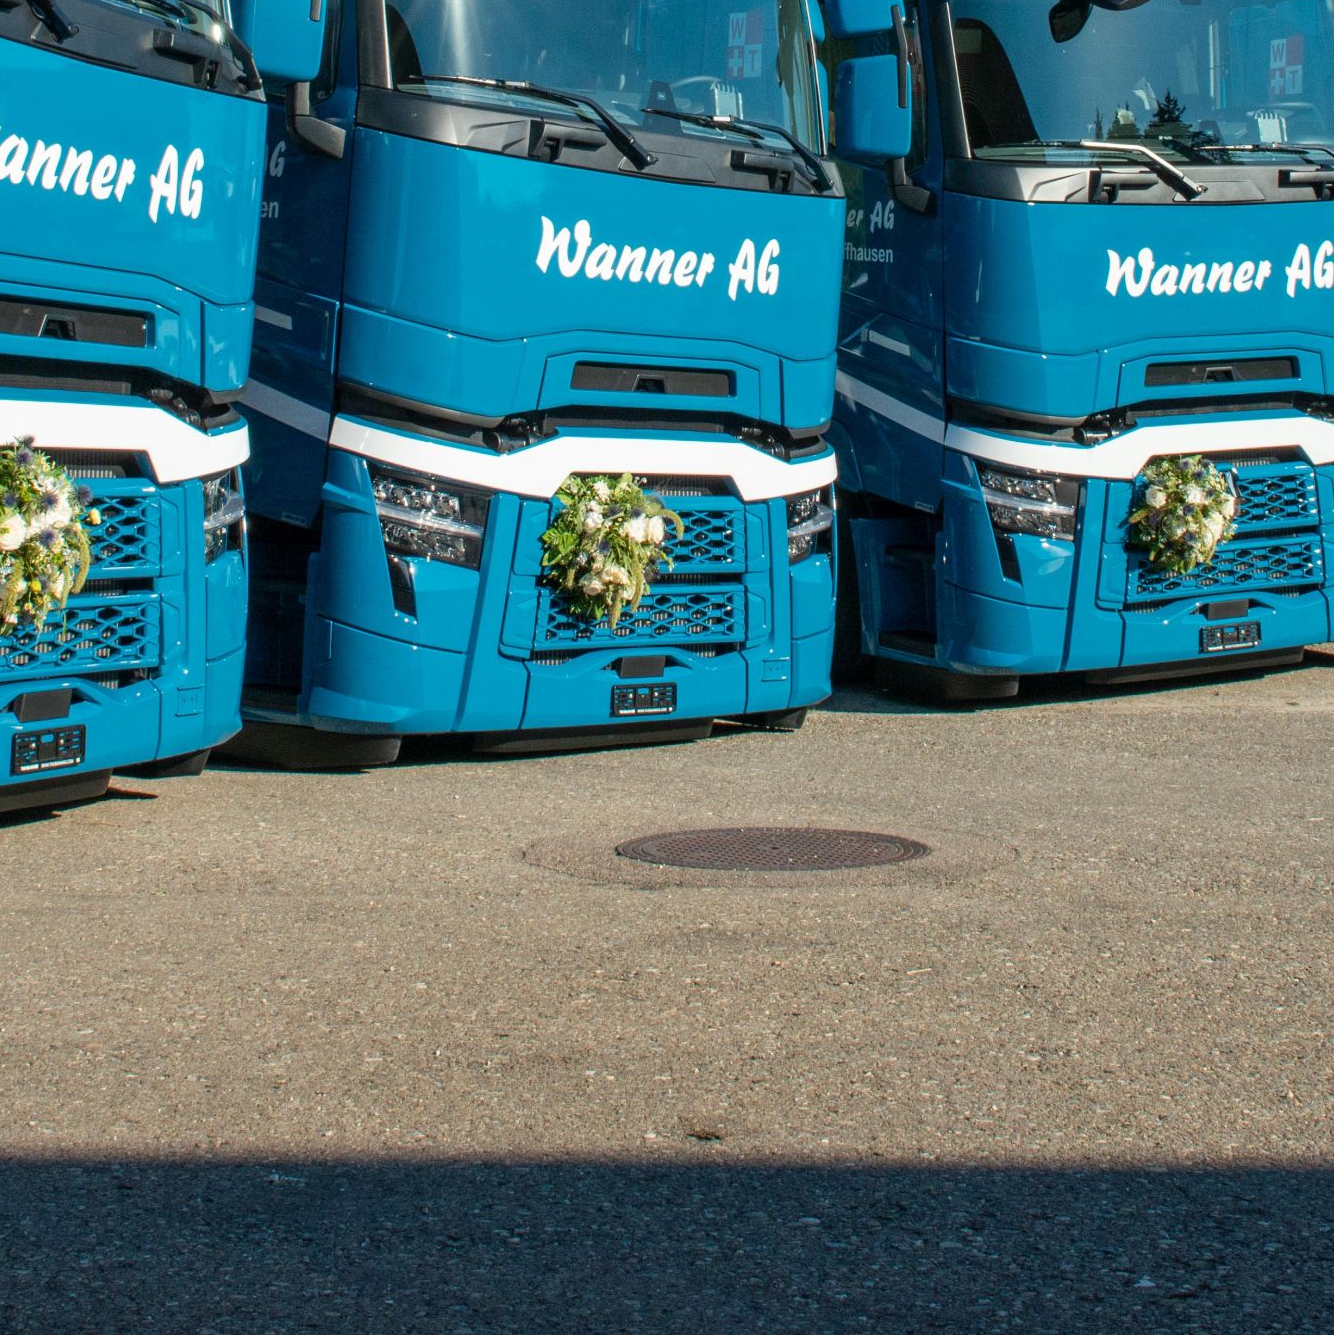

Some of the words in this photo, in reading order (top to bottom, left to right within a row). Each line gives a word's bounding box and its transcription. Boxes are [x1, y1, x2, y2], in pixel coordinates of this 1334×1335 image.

[149, 144, 204, 223] AG
[265, 140, 286, 177] G
[870, 199, 895, 233] AG
[536, 216, 715, 287] Wanner
[728, 238, 780, 301] AG
[1105, 247, 1272, 297] Wanner
[1285, 240, 1334, 298] AG
